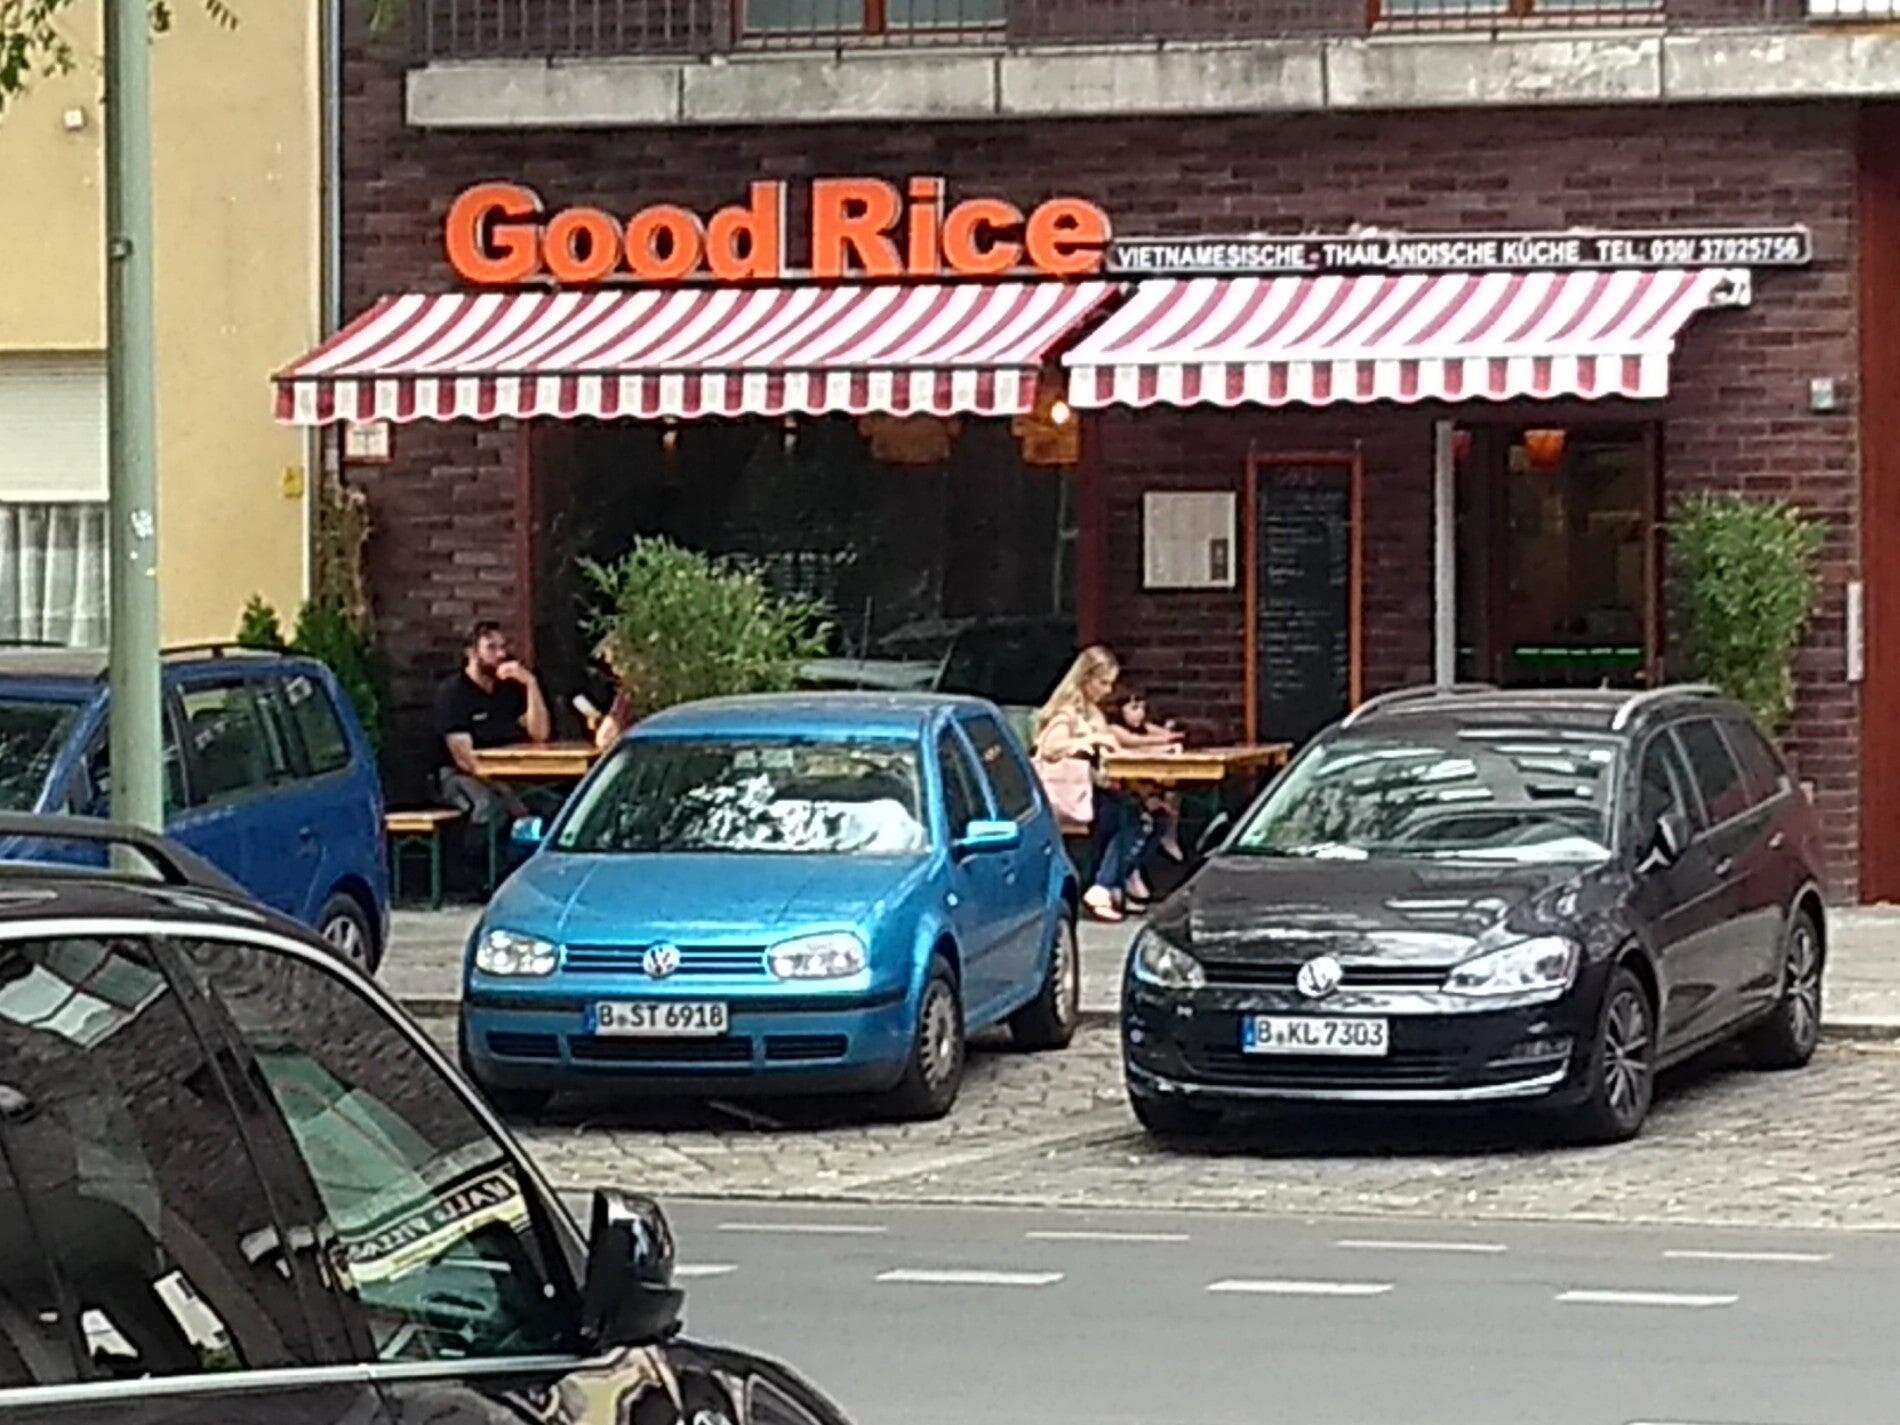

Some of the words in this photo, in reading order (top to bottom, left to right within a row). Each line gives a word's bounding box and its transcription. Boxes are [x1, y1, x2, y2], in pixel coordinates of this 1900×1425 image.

[446, 180, 786, 284] Good
[813, 176, 1111, 279] Rice
[1117, 244, 1306, 267] VIETNAMESISCHE
[1322, 239, 1497, 267] THAILÄNDISCHE
[1502, 238, 1580, 264] KÜCHE
[599, 1004, 614, 1027] B
[631, 1004, 659, 1028] ST
[665, 1004, 723, 1028] 6918
[1258, 1020, 1272, 1043] B
[1288, 1021, 1319, 1045] KL
[1324, 1022, 1383, 1046] 7303
